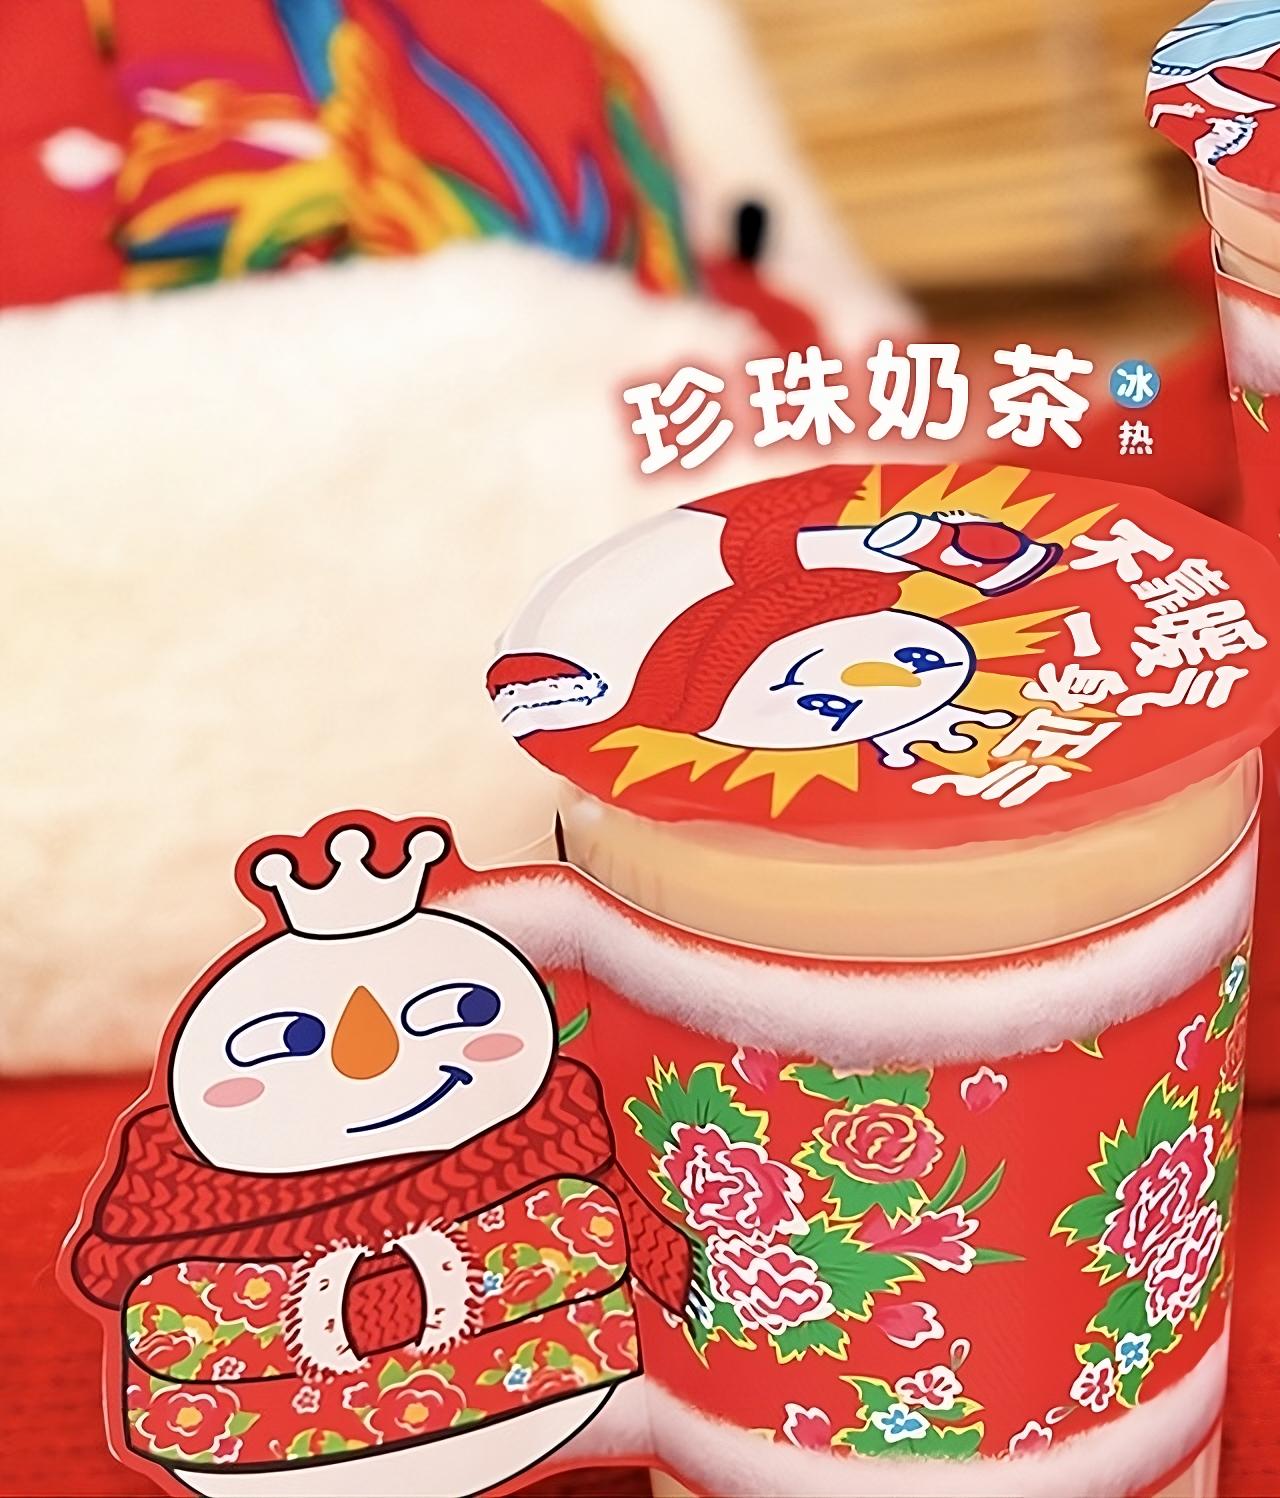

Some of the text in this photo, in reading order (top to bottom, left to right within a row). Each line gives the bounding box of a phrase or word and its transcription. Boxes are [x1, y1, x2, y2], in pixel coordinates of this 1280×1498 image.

[911, 611, 1128, 808] 一身正气
[1069, 518, 1267, 717] 不靠暖气
